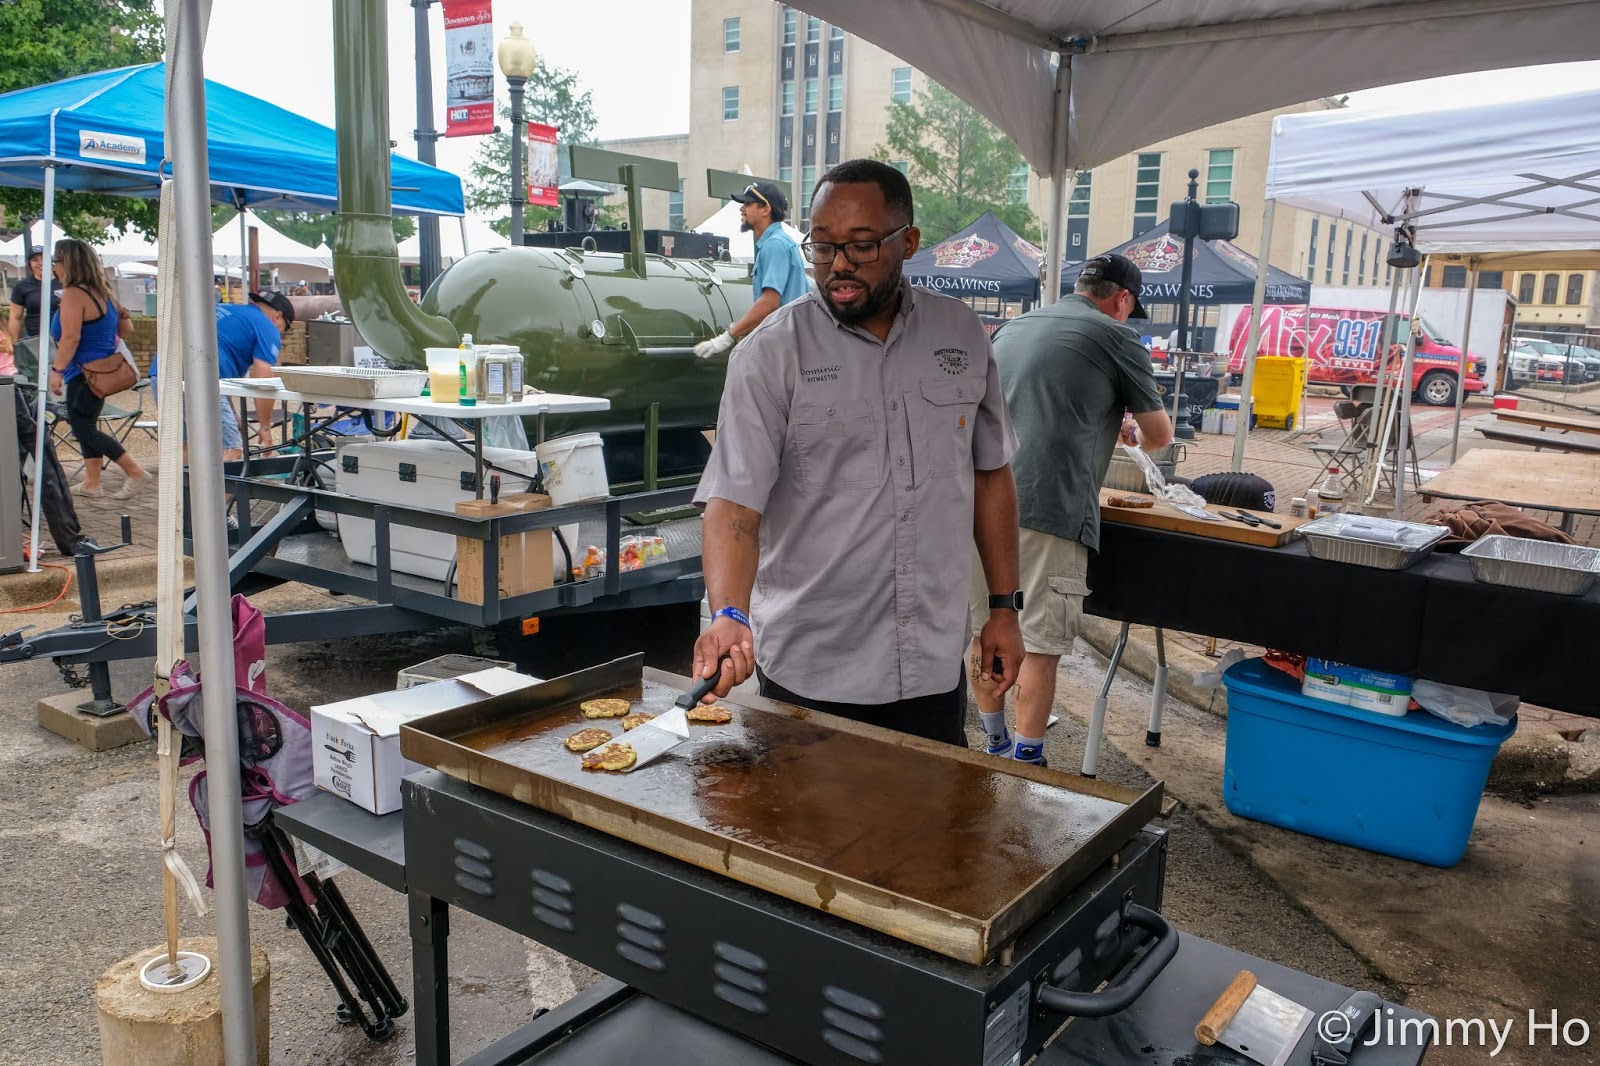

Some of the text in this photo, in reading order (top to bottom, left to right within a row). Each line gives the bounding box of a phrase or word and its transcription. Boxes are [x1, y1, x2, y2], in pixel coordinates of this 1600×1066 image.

[444, 15, 475, 26] Downtown
[100, 140, 141, 155] Academy
[959, 278, 1001, 292] WINES
[1138, 283, 1214, 299] OSA WNES
[1283, 311, 1307, 319] Today'
[1332, 318, 1382, 360] 93.1
[1334, 359, 1368, 369] KTYL
[800, 365, 841, 376] Dominic
[807, 374, 838, 382] PITMASTER
[1187, 405, 1203, 414] NES
